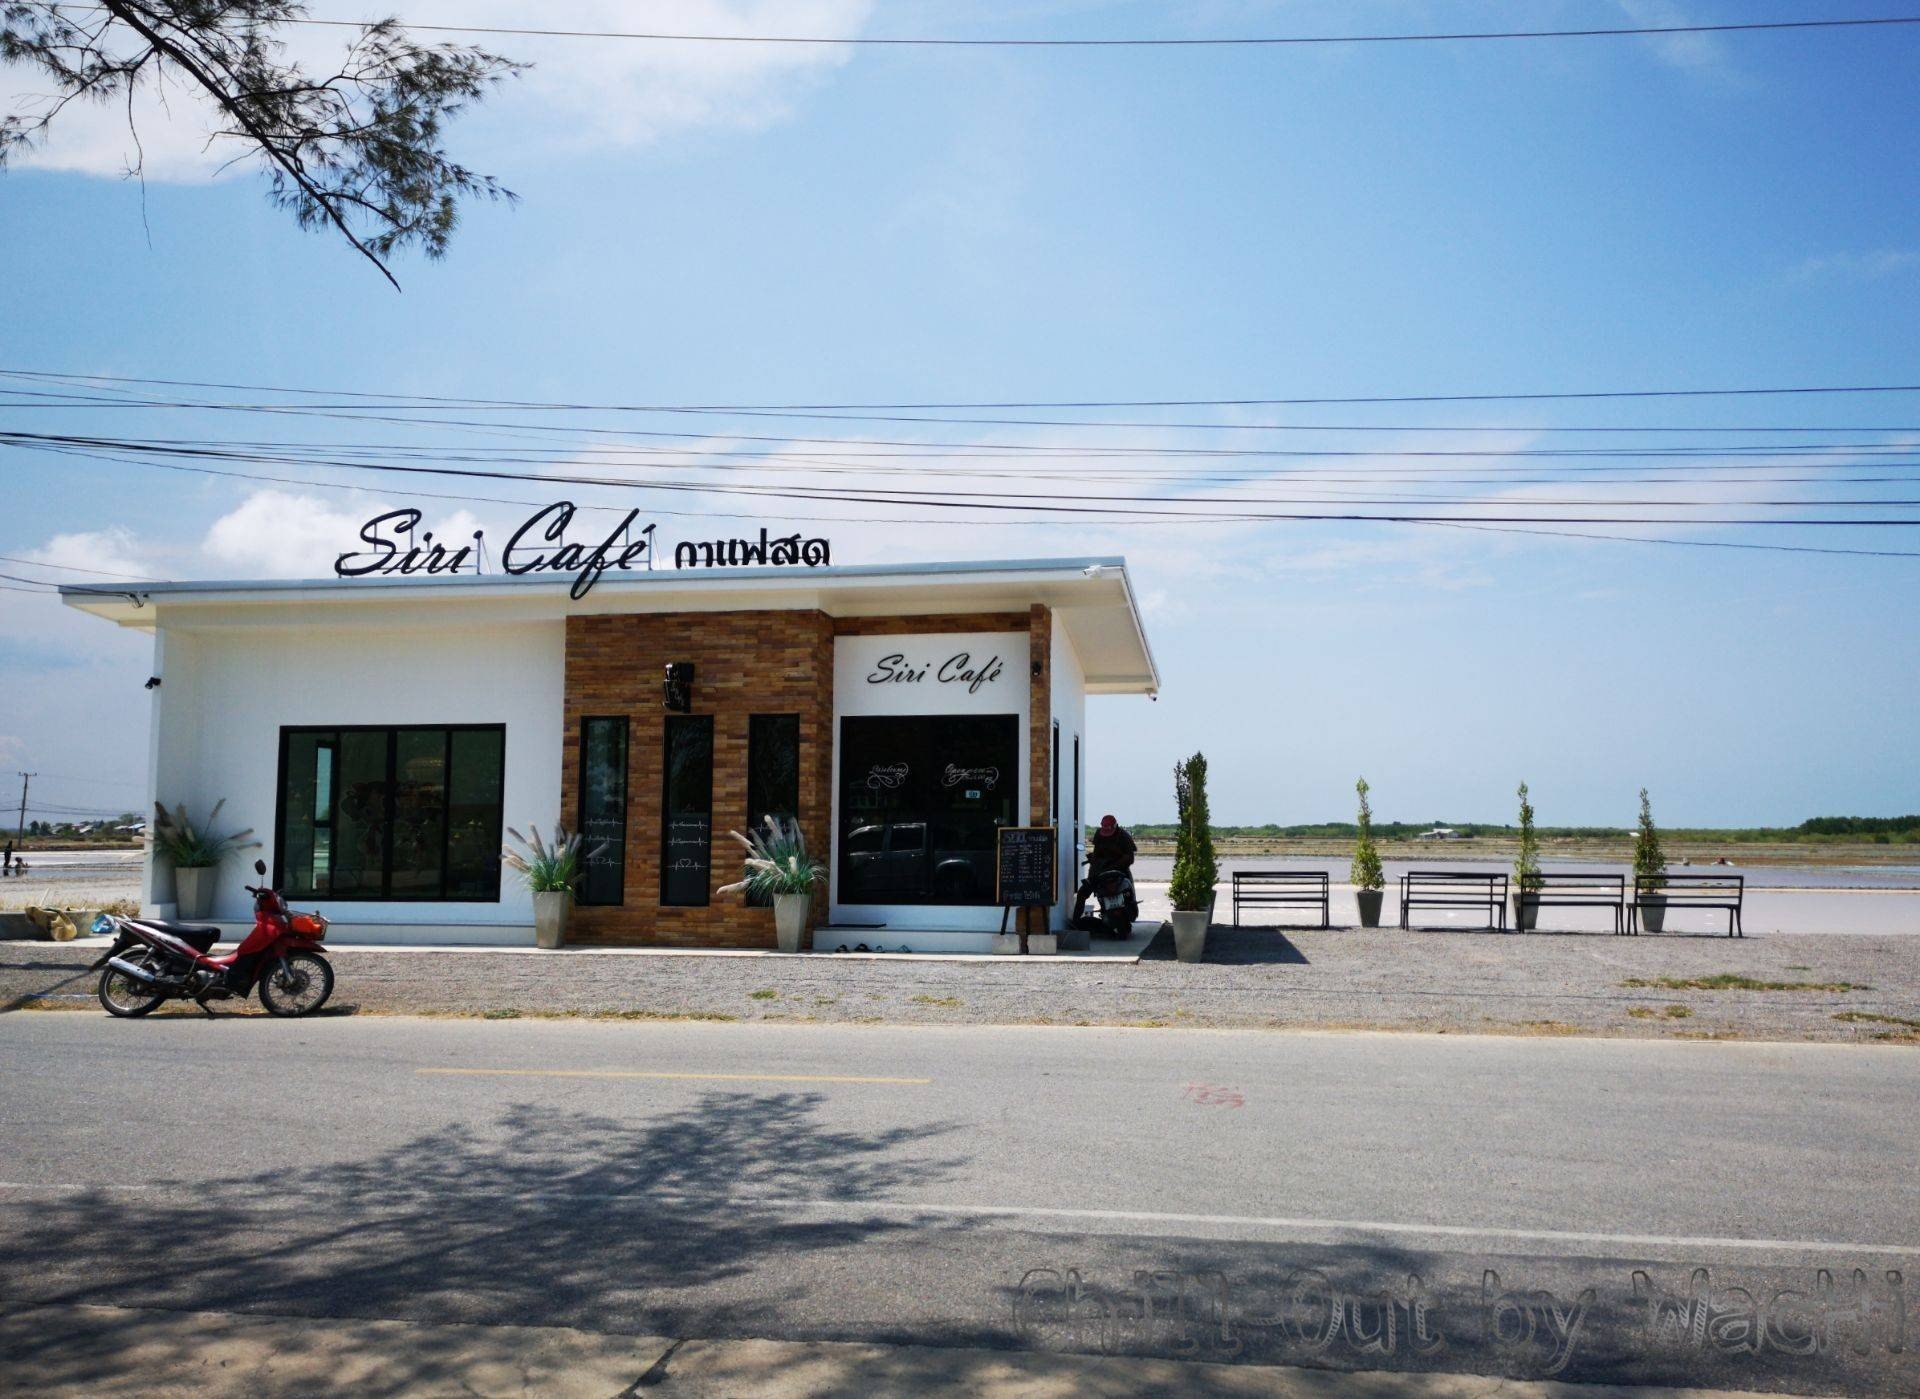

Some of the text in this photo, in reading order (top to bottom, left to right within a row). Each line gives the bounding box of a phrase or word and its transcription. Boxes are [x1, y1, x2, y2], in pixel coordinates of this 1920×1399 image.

[334, 500, 656, 599] Siri Café
[675, 528, 830, 569] กาแฟสด
[867, 652, 1003, 694] Siri Café
